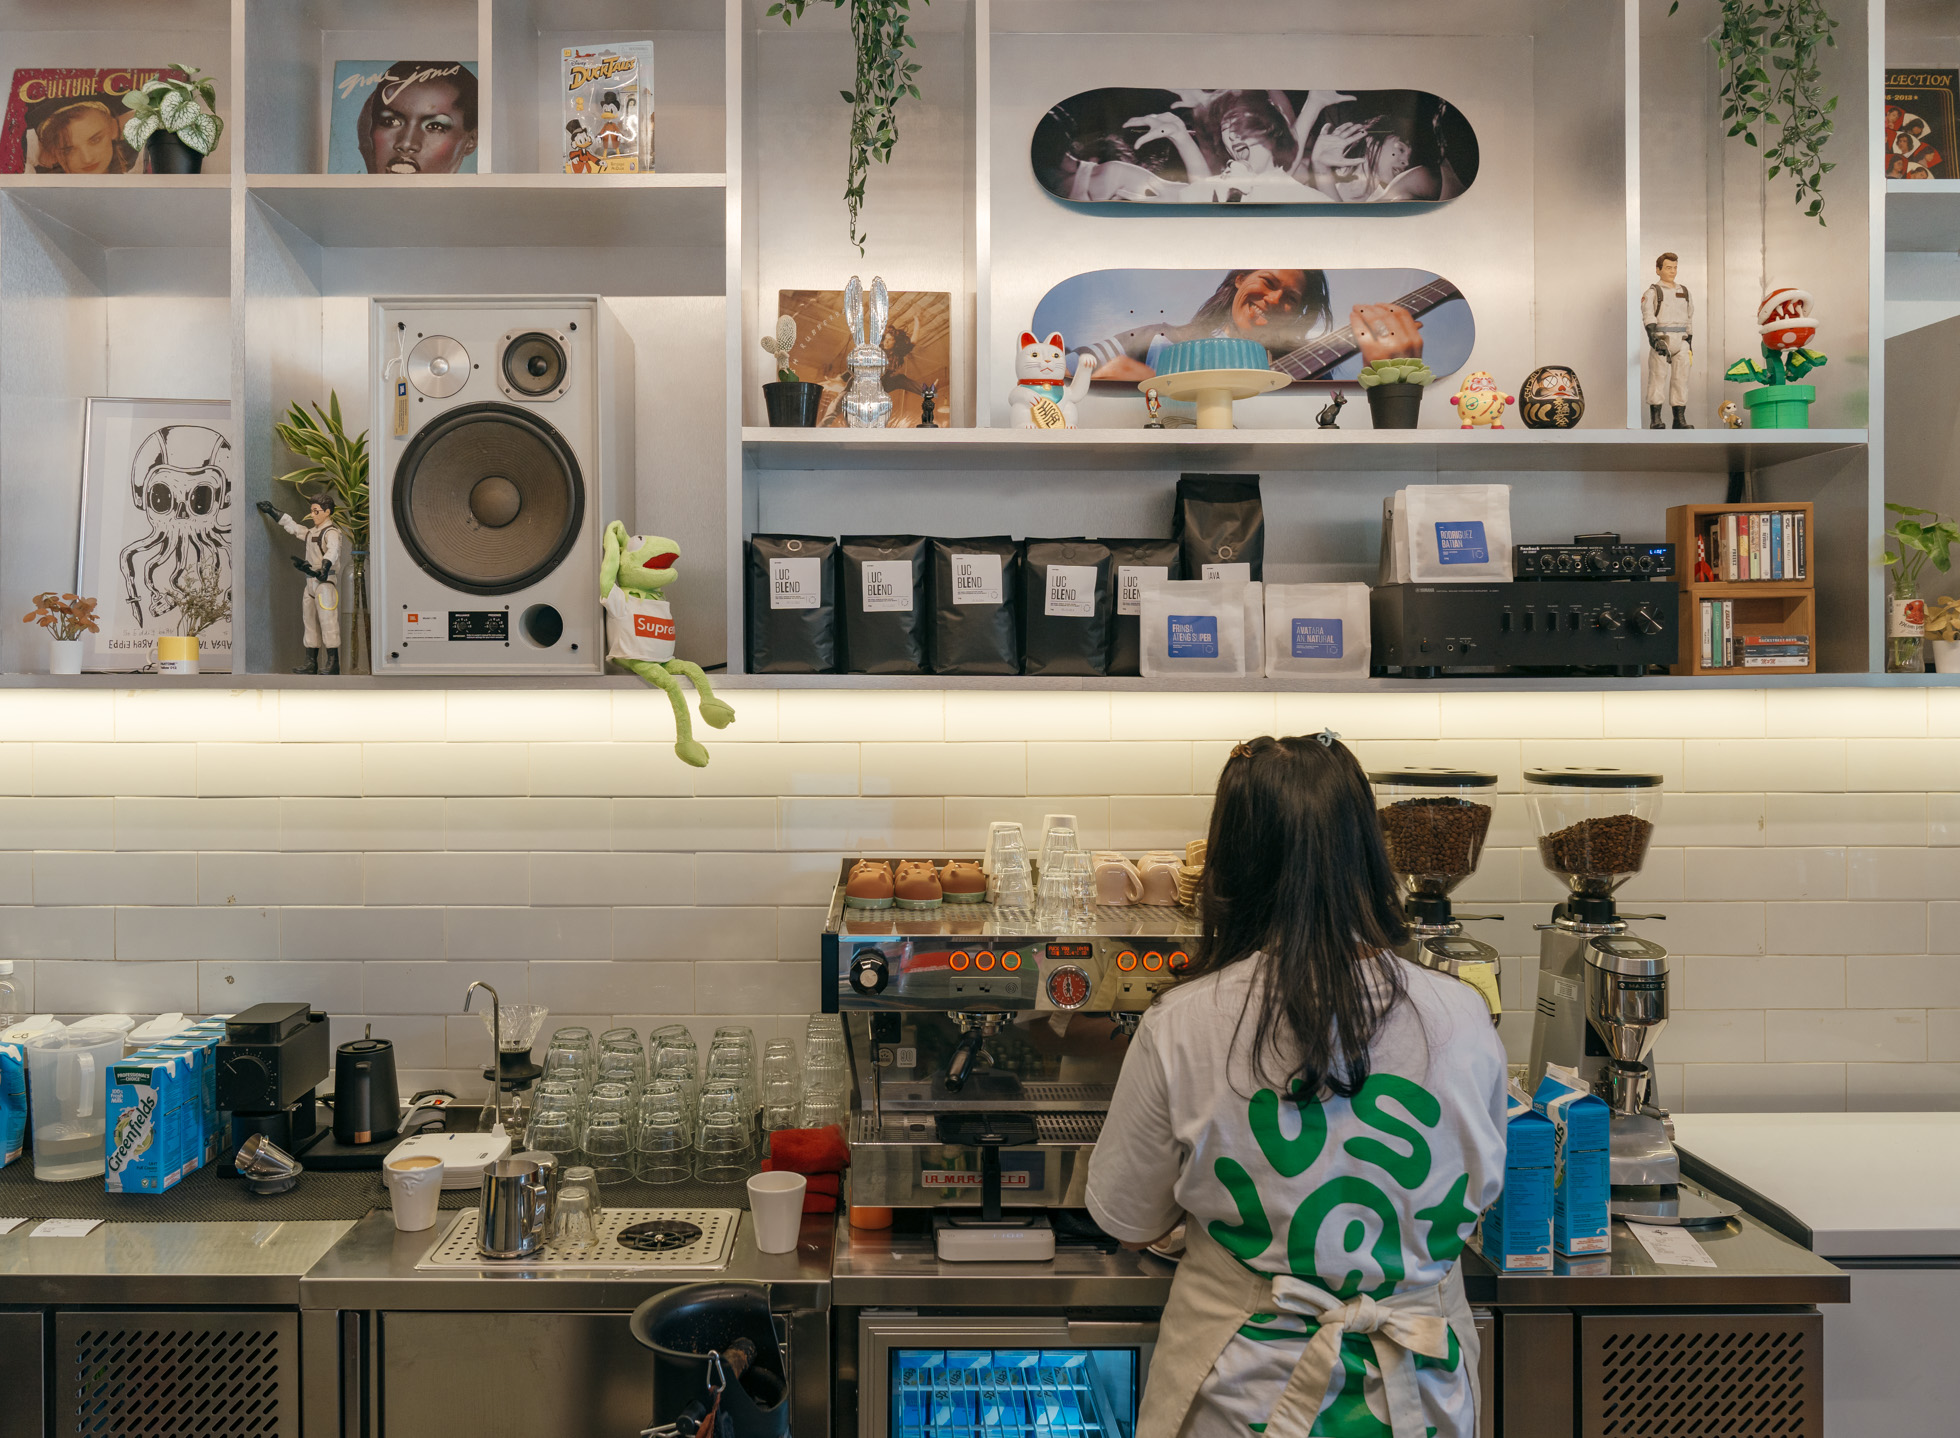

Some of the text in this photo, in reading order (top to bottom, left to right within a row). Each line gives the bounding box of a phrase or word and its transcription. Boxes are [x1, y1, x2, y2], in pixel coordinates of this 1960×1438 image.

[19, 72, 156, 103] CULTURE CLU
[775, 569, 790, 580] LUC
[957, 564, 972, 576] LUC
[867, 571, 882, 583] LUC
[958, 576, 982, 588] BLEND
[1051, 575, 1067, 587] LUC
[1123, 576, 1138, 587] LUC
[775, 581, 800, 593] BLEND
[868, 584, 893, 596] BLEND
[1051, 588, 1076, 600] BLEND
[1122, 588, 1141, 600] BLEN
[637, 617, 675, 636] Supre
[1172, 624, 1193, 633] FRINSA
[1296, 626, 1324, 634] AVATARA
[1306, 634, 1334, 644] NATURAL
[109, 1096, 155, 1171] Greenfields
